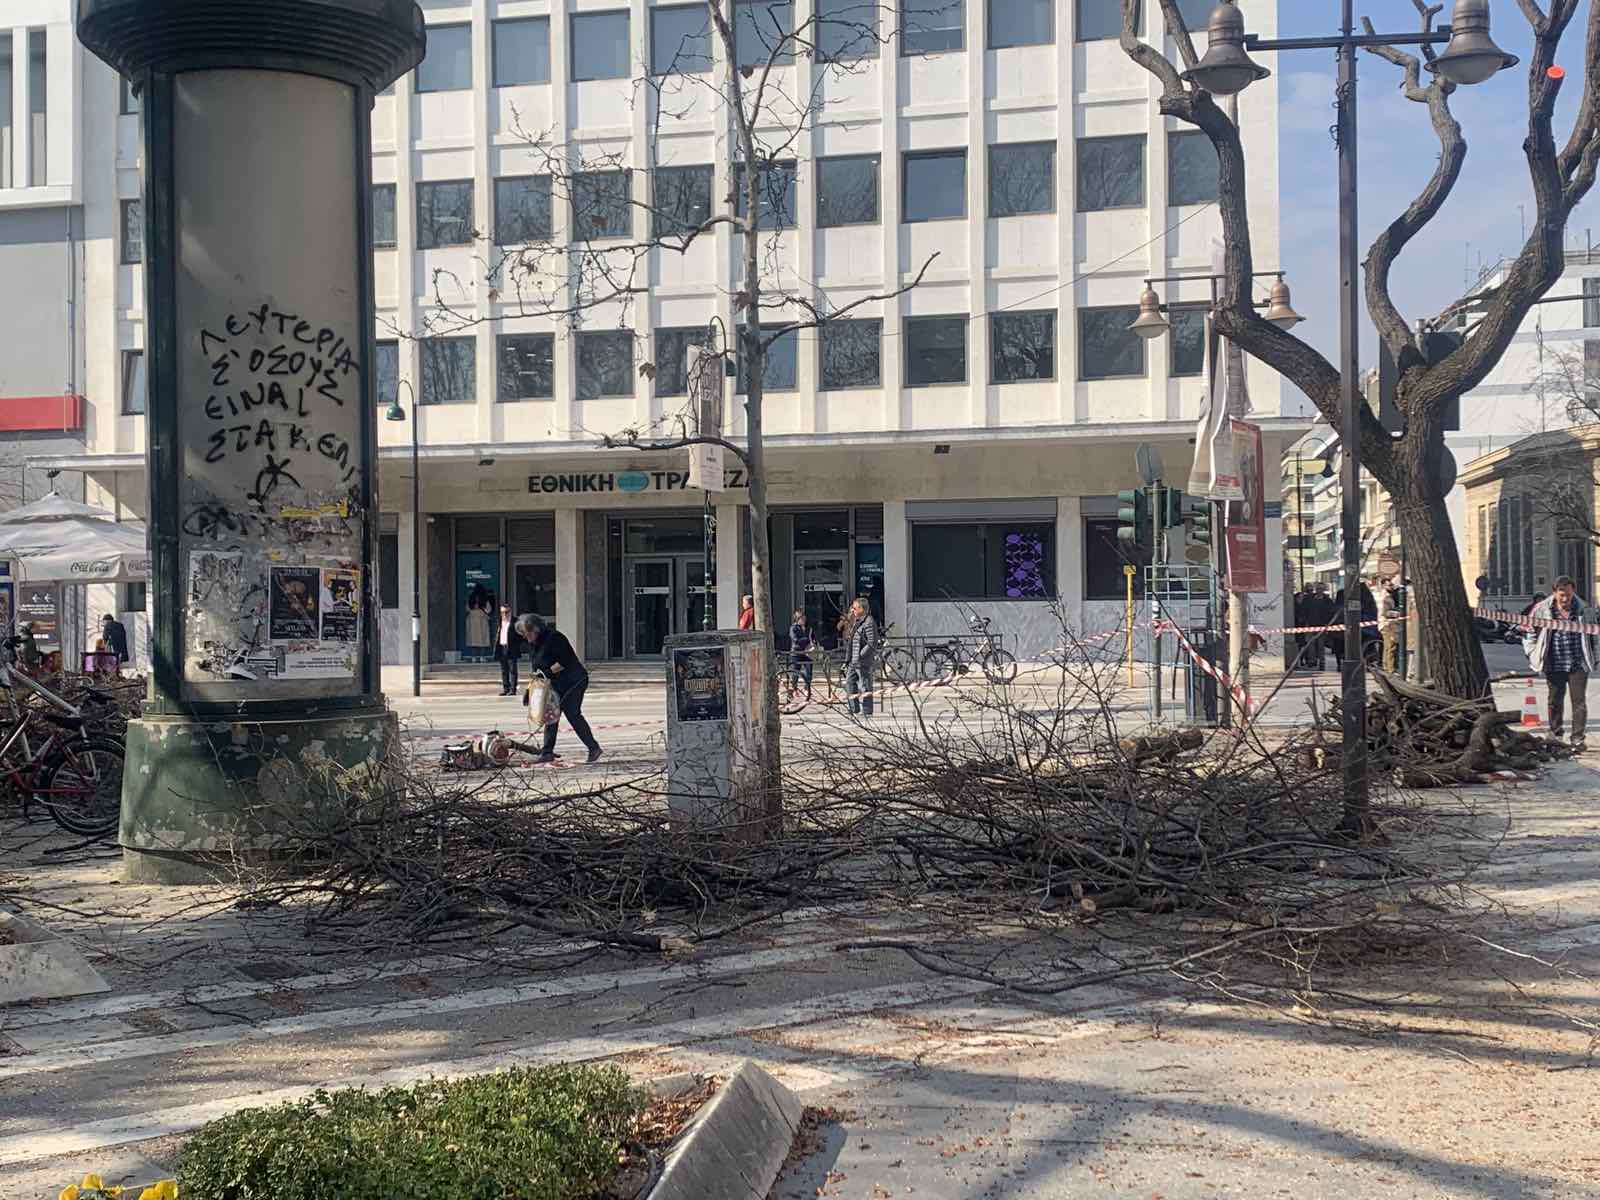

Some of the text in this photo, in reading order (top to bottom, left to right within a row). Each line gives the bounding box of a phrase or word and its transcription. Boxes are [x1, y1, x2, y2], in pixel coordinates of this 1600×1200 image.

[201, 304, 360, 374] ΛΕΥΤΕΡΙΑ
[248, 345, 344, 407] ΟΣΟΥΣ
[205, 382, 310, 420] ΕΙΝΑΙ
[206, 419, 275, 462] ΣΤΑ
[528, 473, 614, 493] ΕΘΝΙΚΗ
